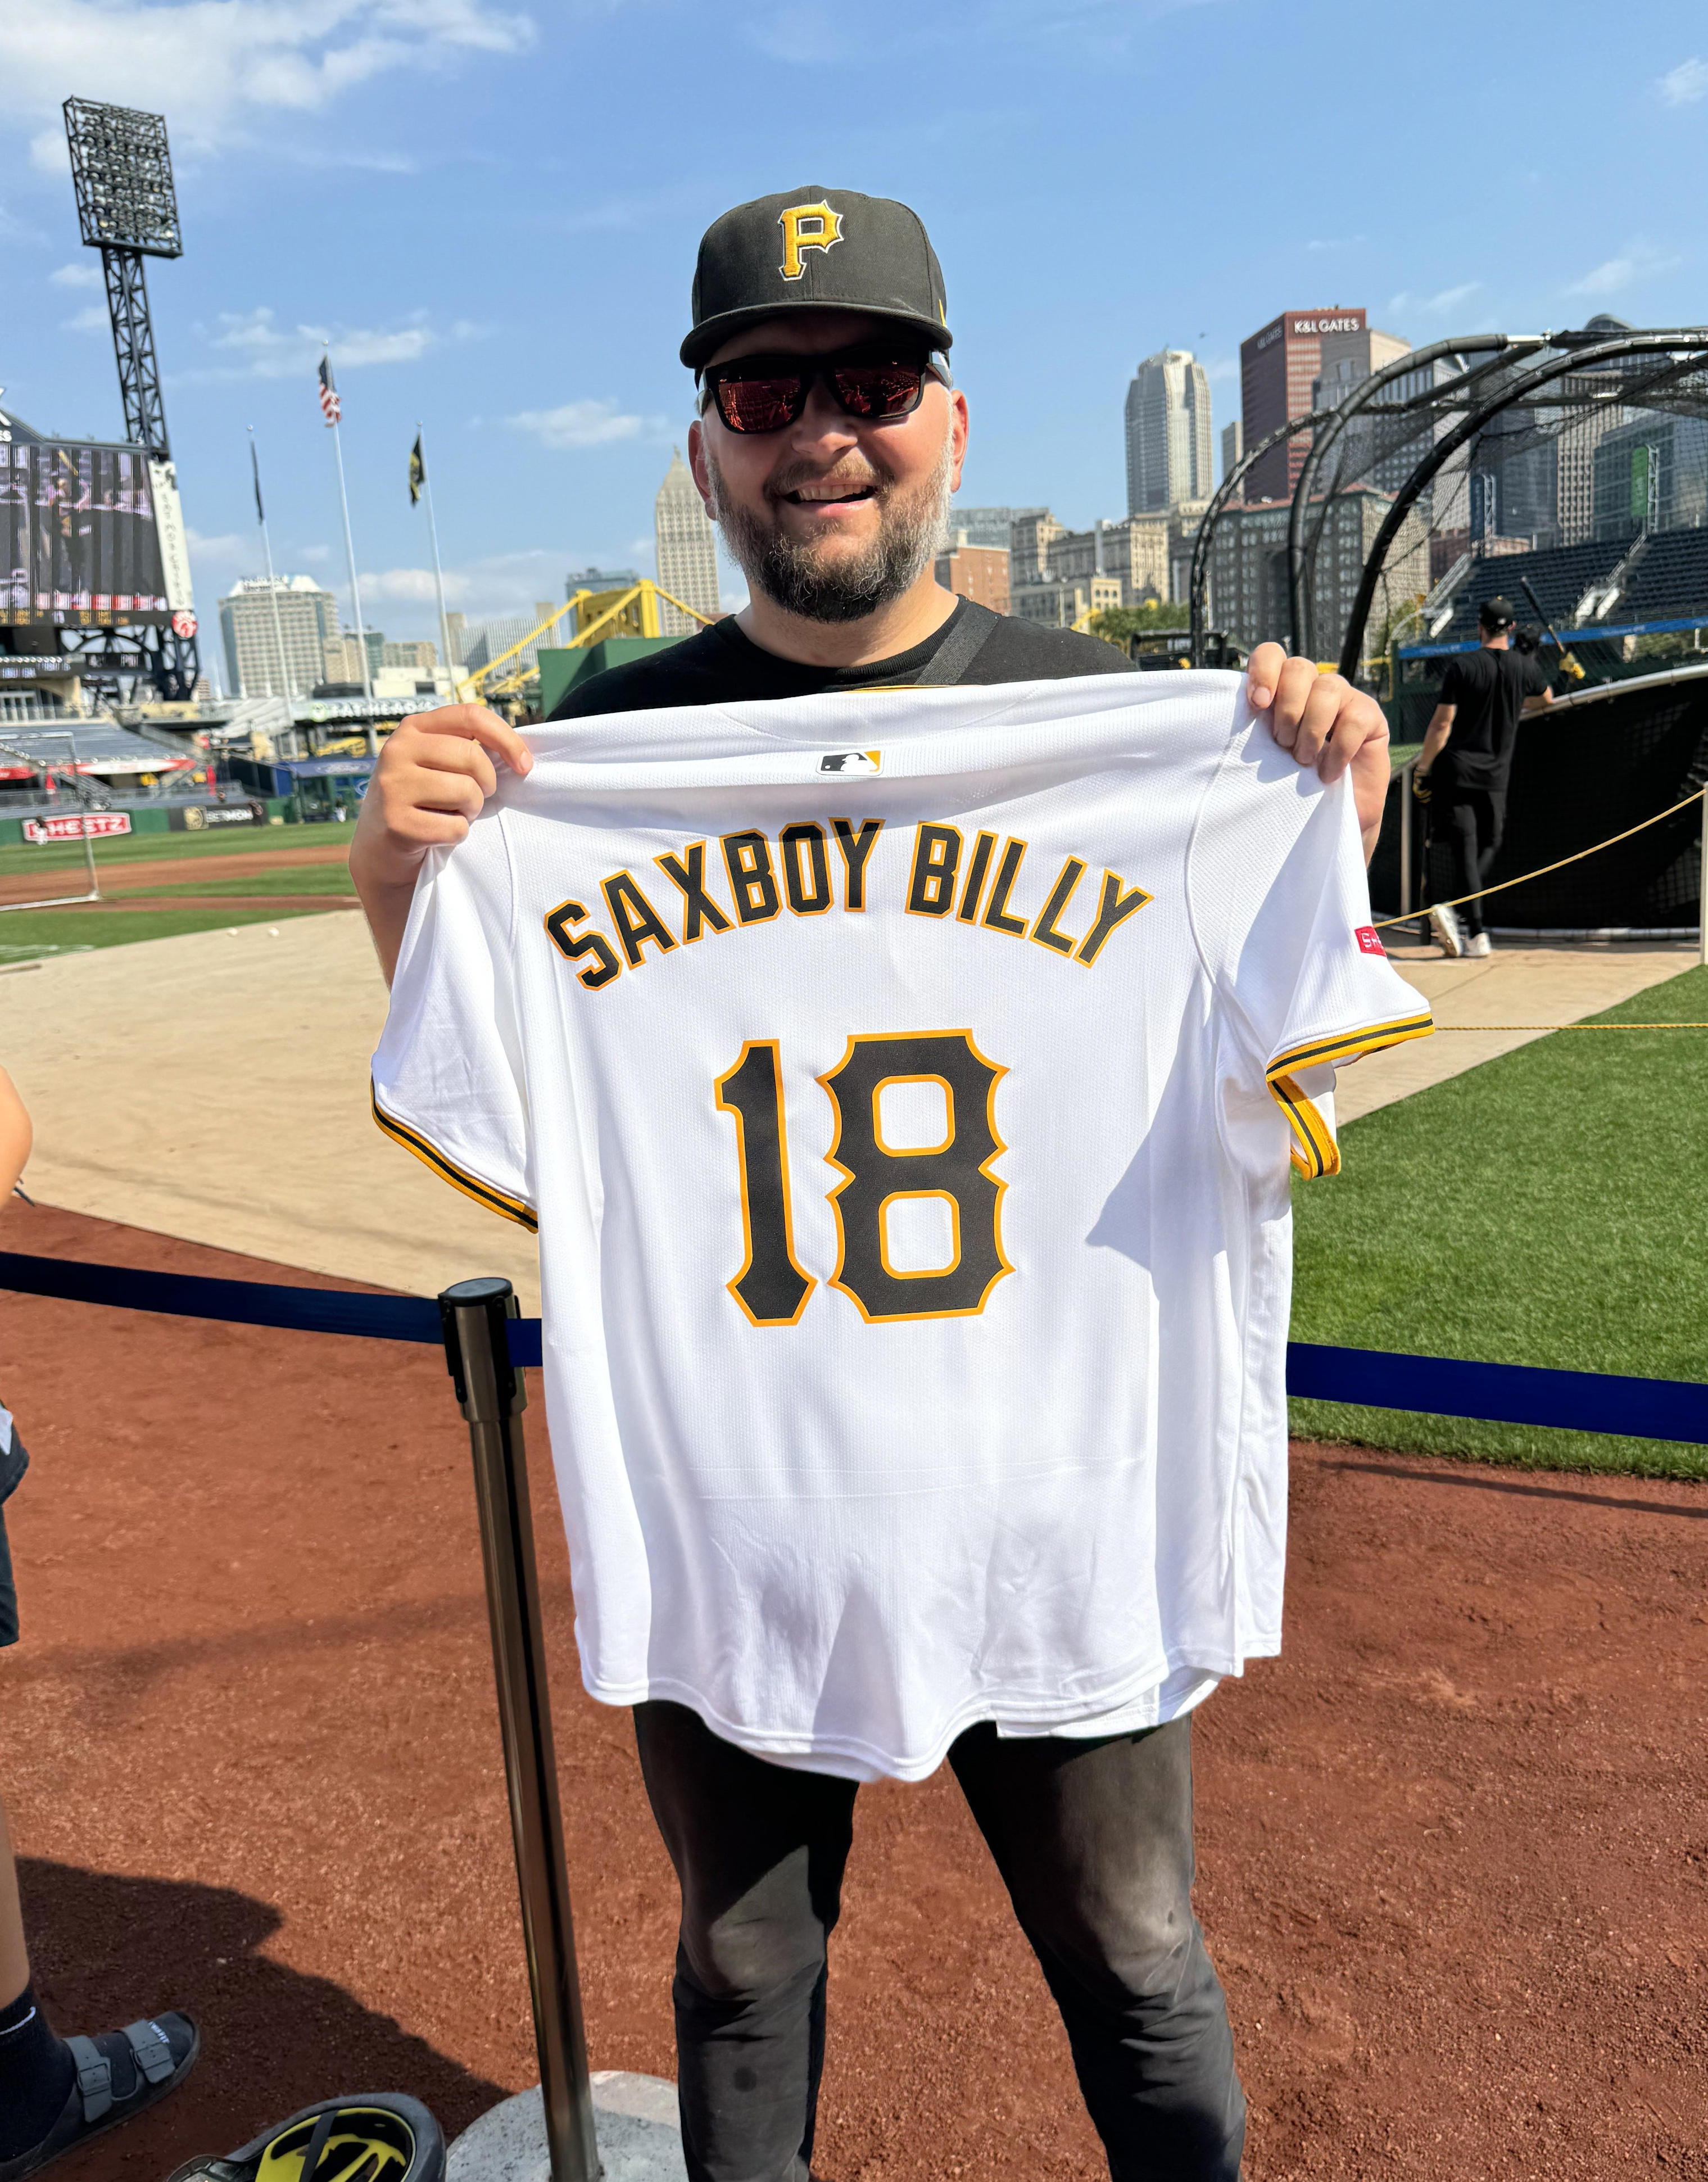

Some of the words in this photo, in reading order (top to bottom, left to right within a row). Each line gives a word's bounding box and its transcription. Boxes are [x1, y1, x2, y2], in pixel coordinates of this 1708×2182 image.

[777, 199, 844, 281] P
[1294, 319, 1319, 333] K&L
[1319, 318, 1360, 332] GATES
[544, 817, 886, 991] SAXBOY
[905, 821, 1154, 969] BILLY
[714, 1028, 1016, 1327] 18
